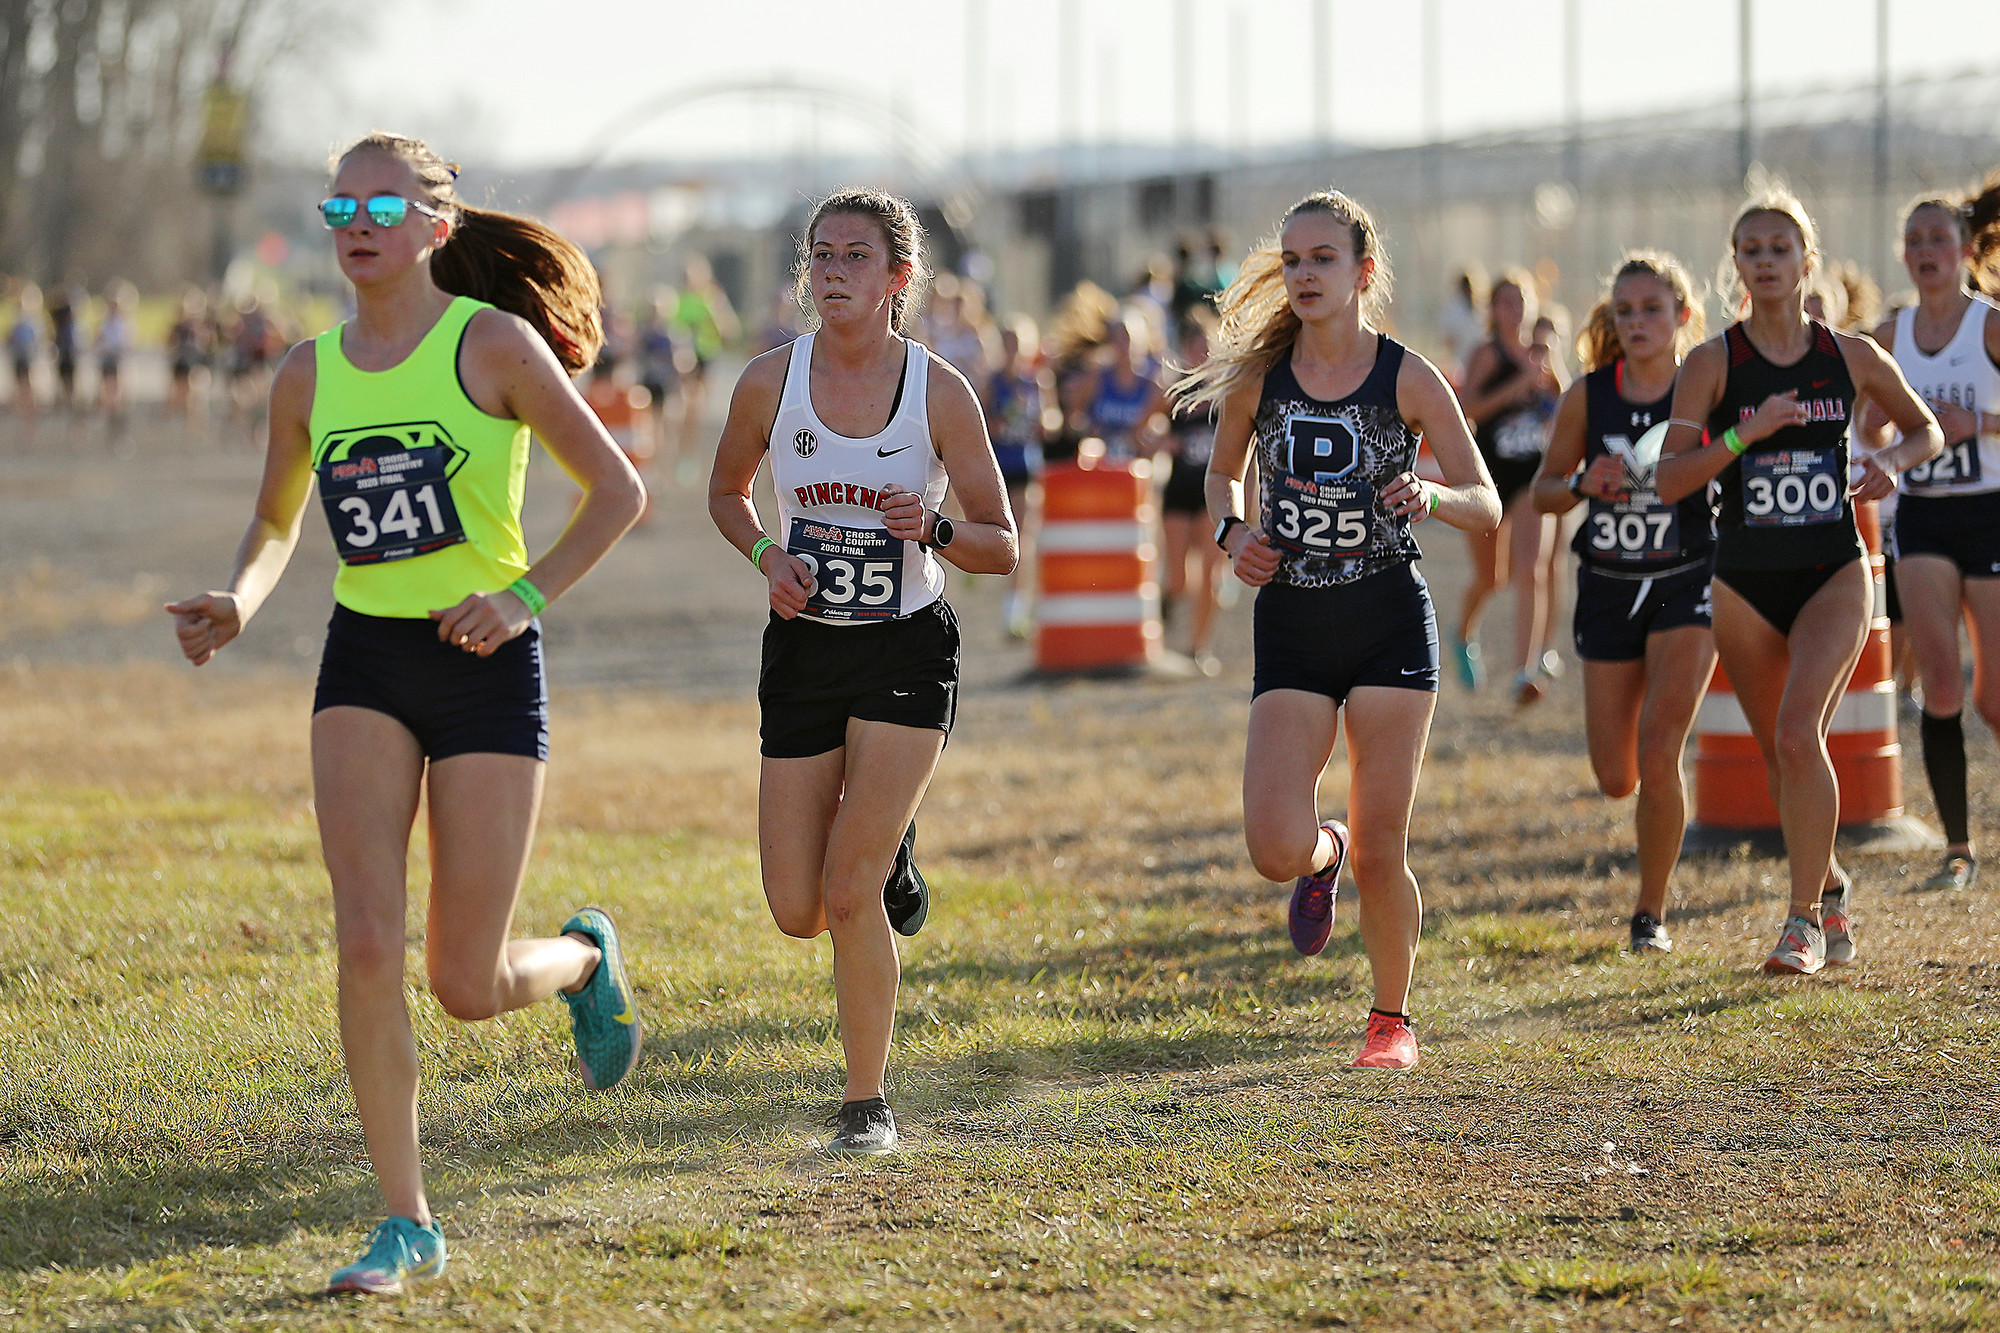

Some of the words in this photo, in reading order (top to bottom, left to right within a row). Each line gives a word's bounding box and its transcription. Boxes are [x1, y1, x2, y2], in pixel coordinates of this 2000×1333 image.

[795, 431, 815, 456] SEC
[377, 452, 411, 465] CROSS
[379, 458, 424, 474] COUNTRY
[356, 477, 379, 490] 2020
[379, 473, 405, 485] FINAL
[1320, 485, 1346, 493] CROSS
[794, 482, 886, 513] PINCKNE
[1300, 494, 1316, 504] 2020
[1317, 498, 1338, 508] FINAL
[1320, 491, 1356, 499] COUNTRY
[1747, 472, 1837, 515] 300
[338, 484, 446, 548] 341
[1276, 499, 1367, 548] 325
[845, 530, 876, 539] CROSS
[1592, 512, 1673, 551] 307
[820, 543, 840, 553] 2020
[842, 546, 866, 556] FINAL
[845, 538, 887, 546] COUNTRY
